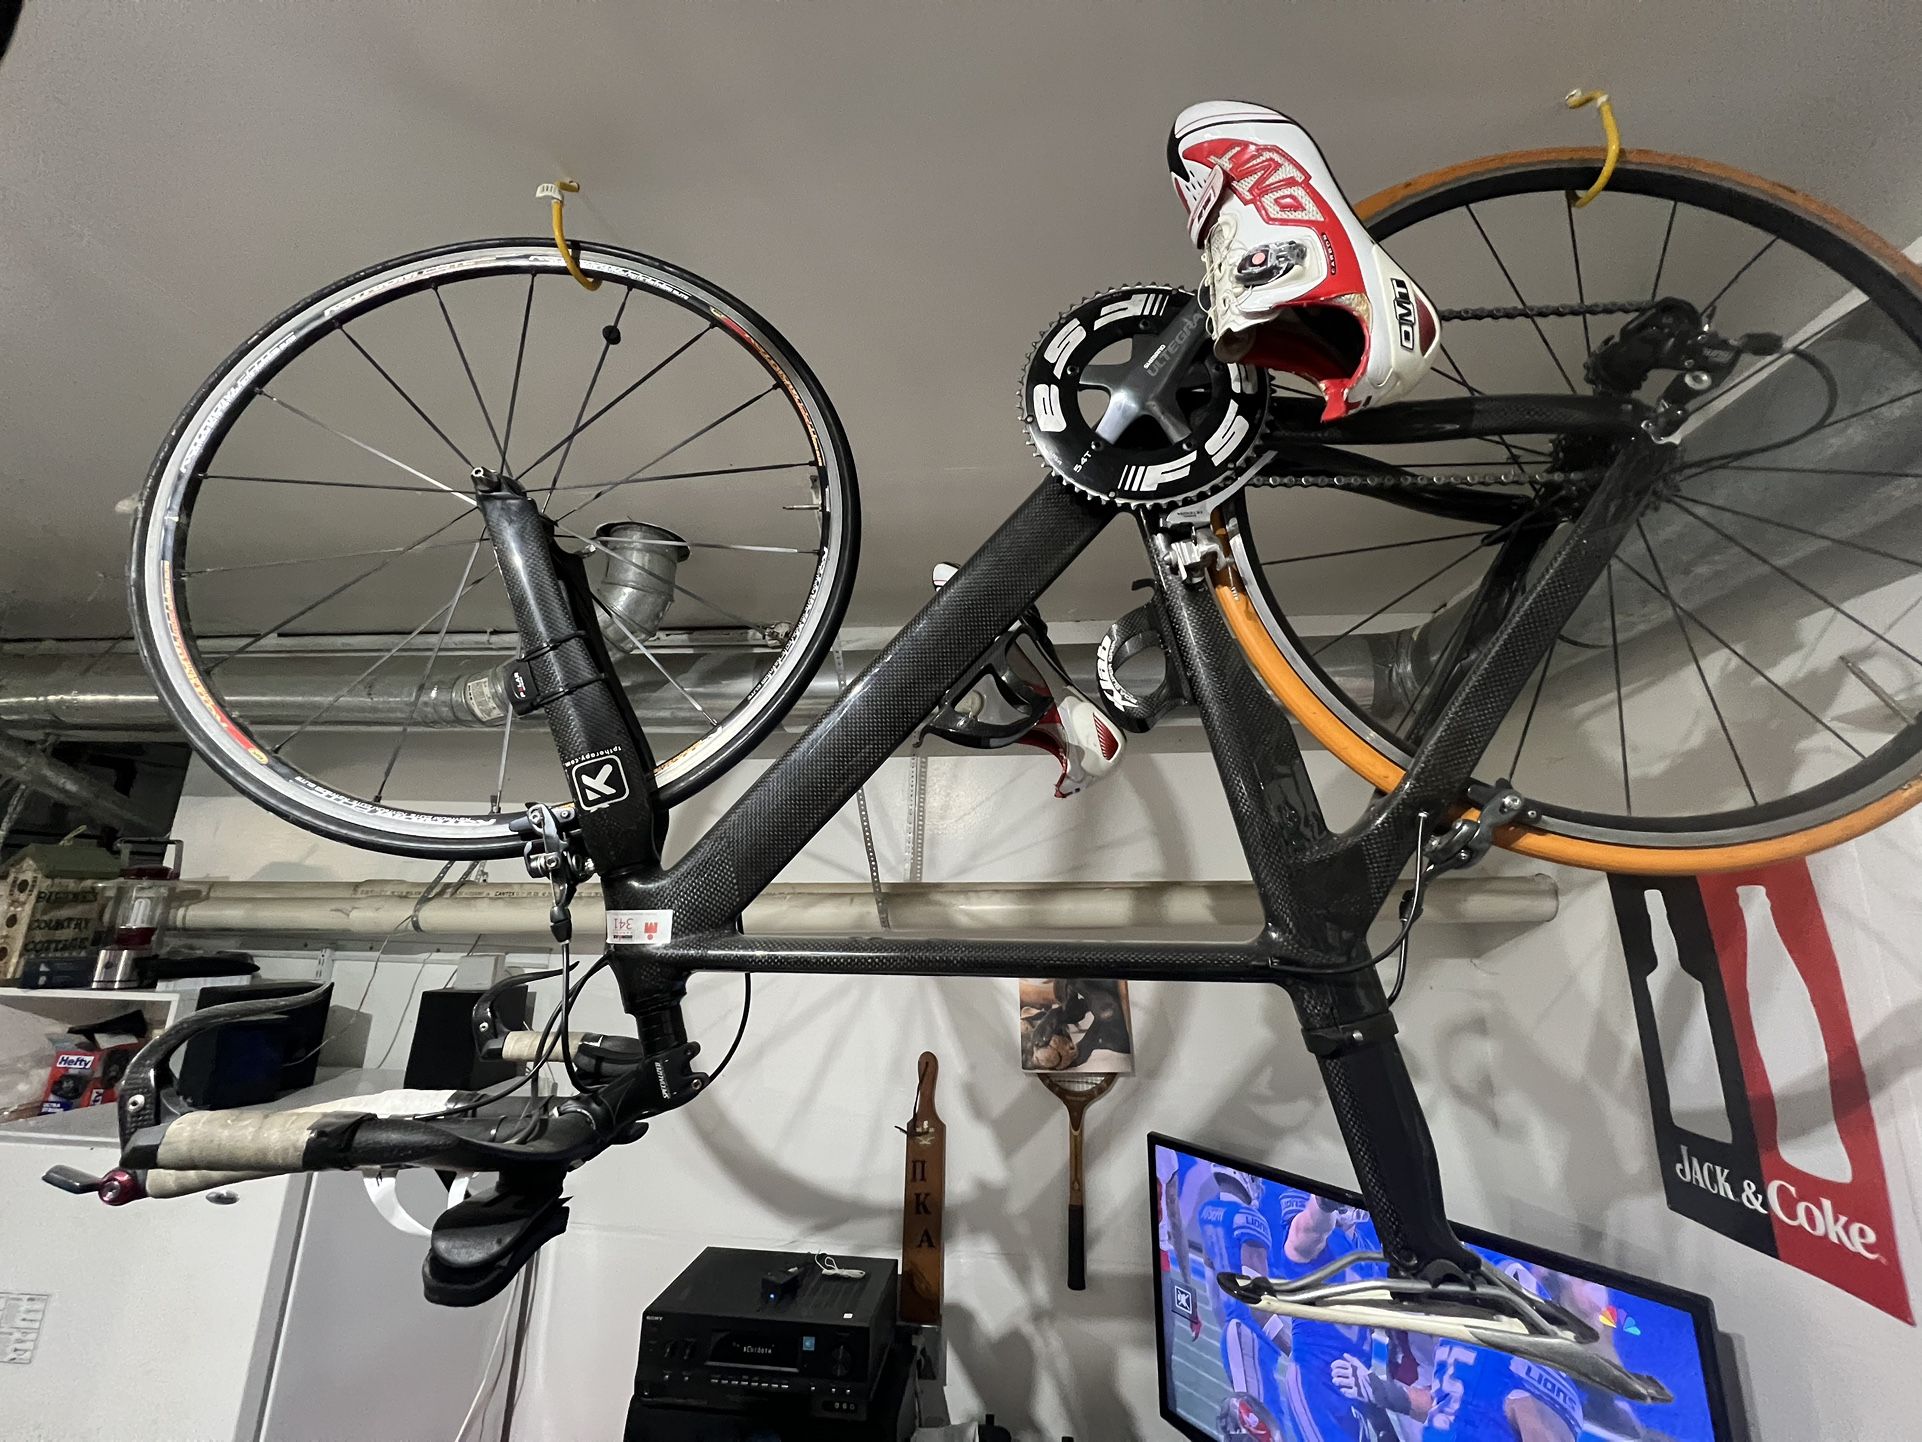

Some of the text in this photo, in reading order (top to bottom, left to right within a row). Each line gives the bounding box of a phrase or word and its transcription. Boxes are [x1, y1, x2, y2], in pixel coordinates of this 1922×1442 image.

[1322, 233, 1337, 275] CARBON
[1391, 278, 1416, 350] DMT
[1143, 344, 1166, 369] SHIMANO
[1147, 311, 1204, 376] ULTEGRA
[1073, 450, 1092, 473] 54T
[513, 671, 526, 698] POLAR
[565, 745, 622, 767] tptherapy.com
[614, 918, 633, 930] 341
[59, 1056, 91, 1067] Hefty
[654, 1061, 670, 1099] SPECIALIZED
[1741, 1179, 1769, 1214] &
[1767, 1179, 1878, 1261] Coke
[1524, 1365, 1577, 1412] LIONS
